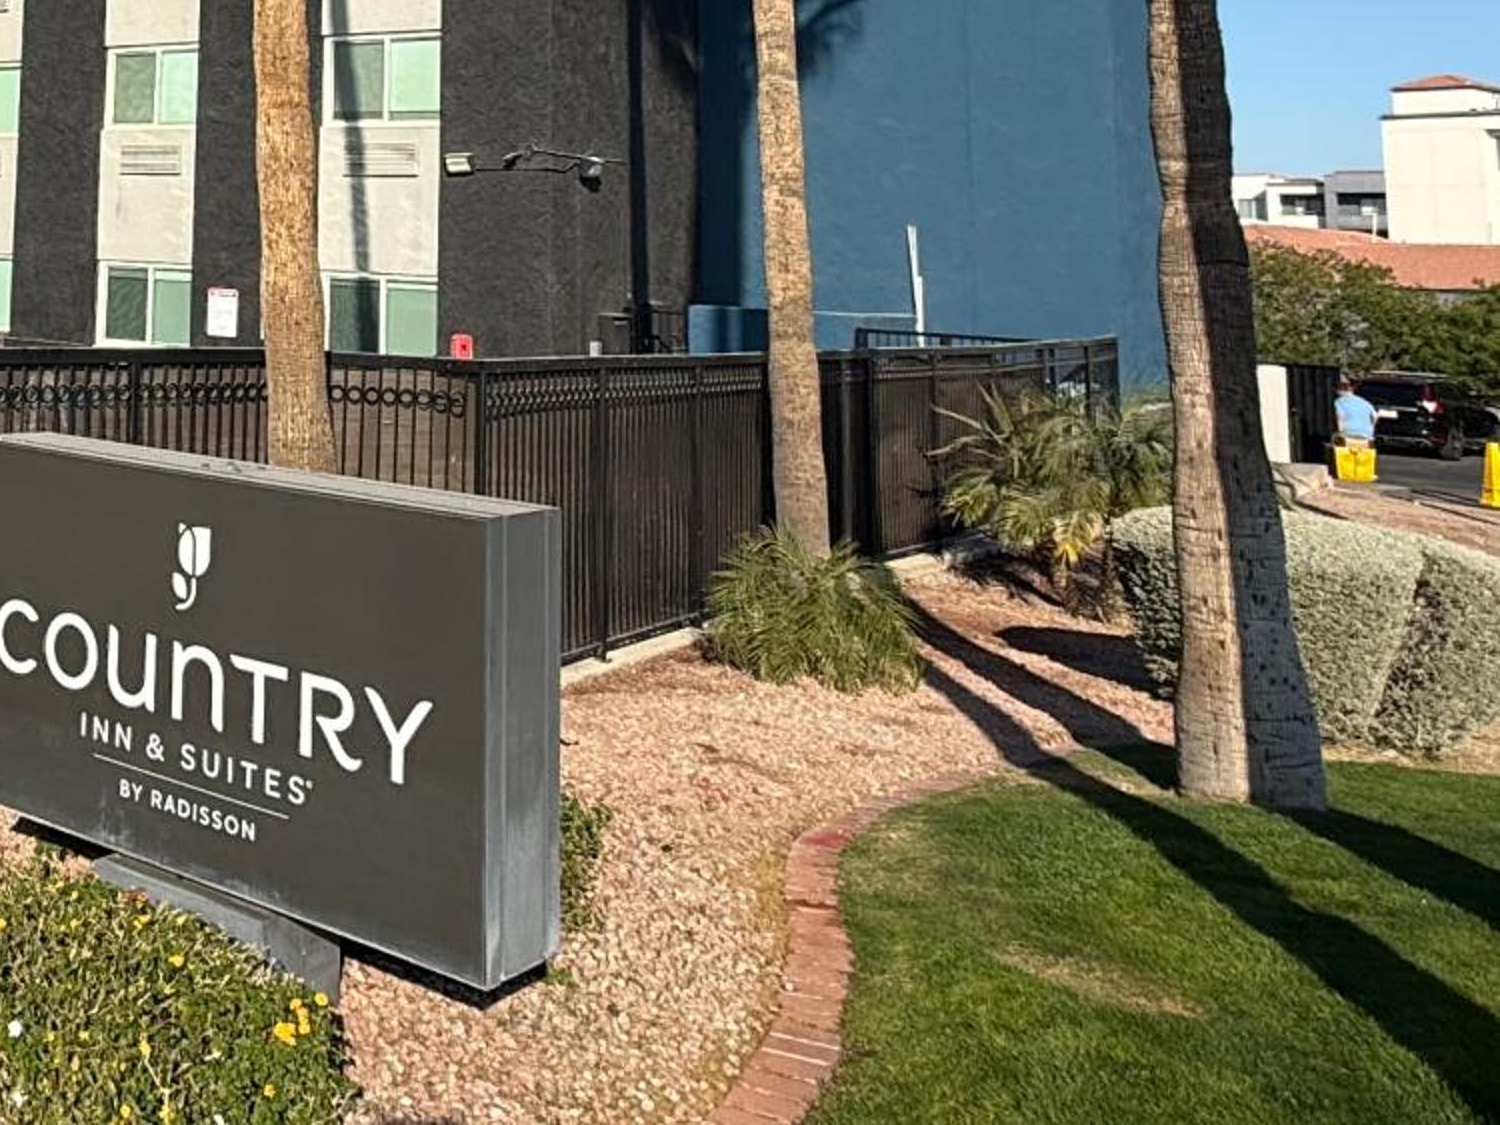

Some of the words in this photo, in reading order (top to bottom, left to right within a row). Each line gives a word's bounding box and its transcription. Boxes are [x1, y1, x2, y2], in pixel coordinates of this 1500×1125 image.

[79, 710, 134, 753] INN
[144, 732, 166, 763] &
[118, 777, 144, 803] BY
[149, 787, 257, 842] RADISSON
